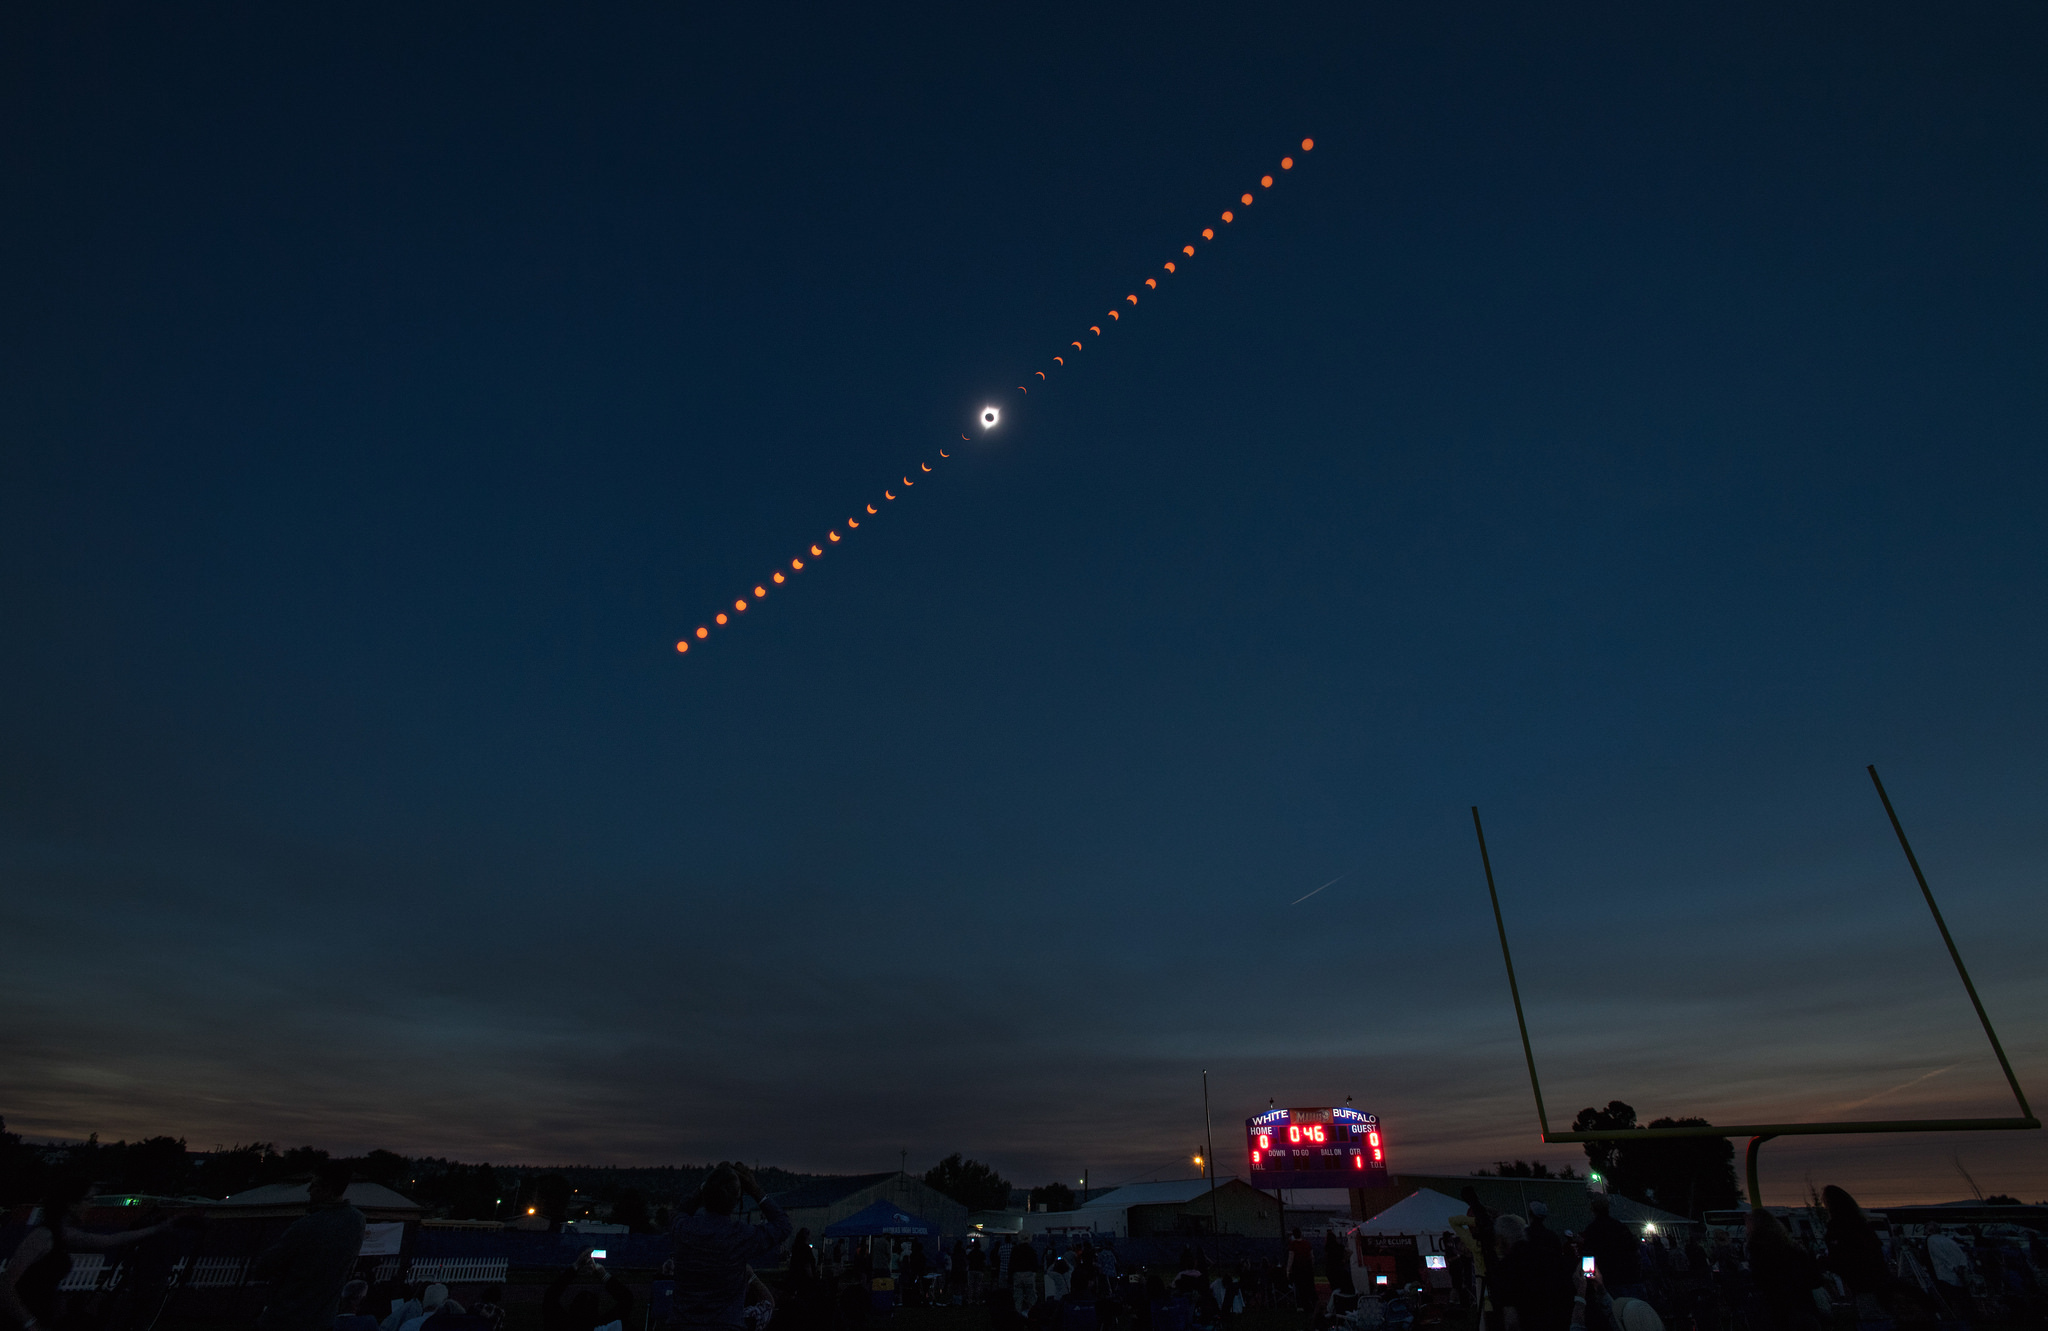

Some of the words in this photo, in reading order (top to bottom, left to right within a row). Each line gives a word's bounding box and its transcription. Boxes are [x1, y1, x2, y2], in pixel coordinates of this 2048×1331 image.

[1252, 1109, 1289, 1125] WHITE
[1332, 1108, 1377, 1123] BUFFALO
[1250, 1127, 1272, 1135] HOME
[1351, 1124, 1377, 1133] GUEST
[1259, 1134, 1269, 1149] 0
[1368, 1132, 1380, 1147] 0
[1252, 1150, 1261, 1163] 3
[1321, 1148, 1334, 1156] BALL
[1334, 1148, 1342, 1156] ON
[1373, 1148, 1382, 1161] 3
[1355, 1155, 1362, 1169] 1
